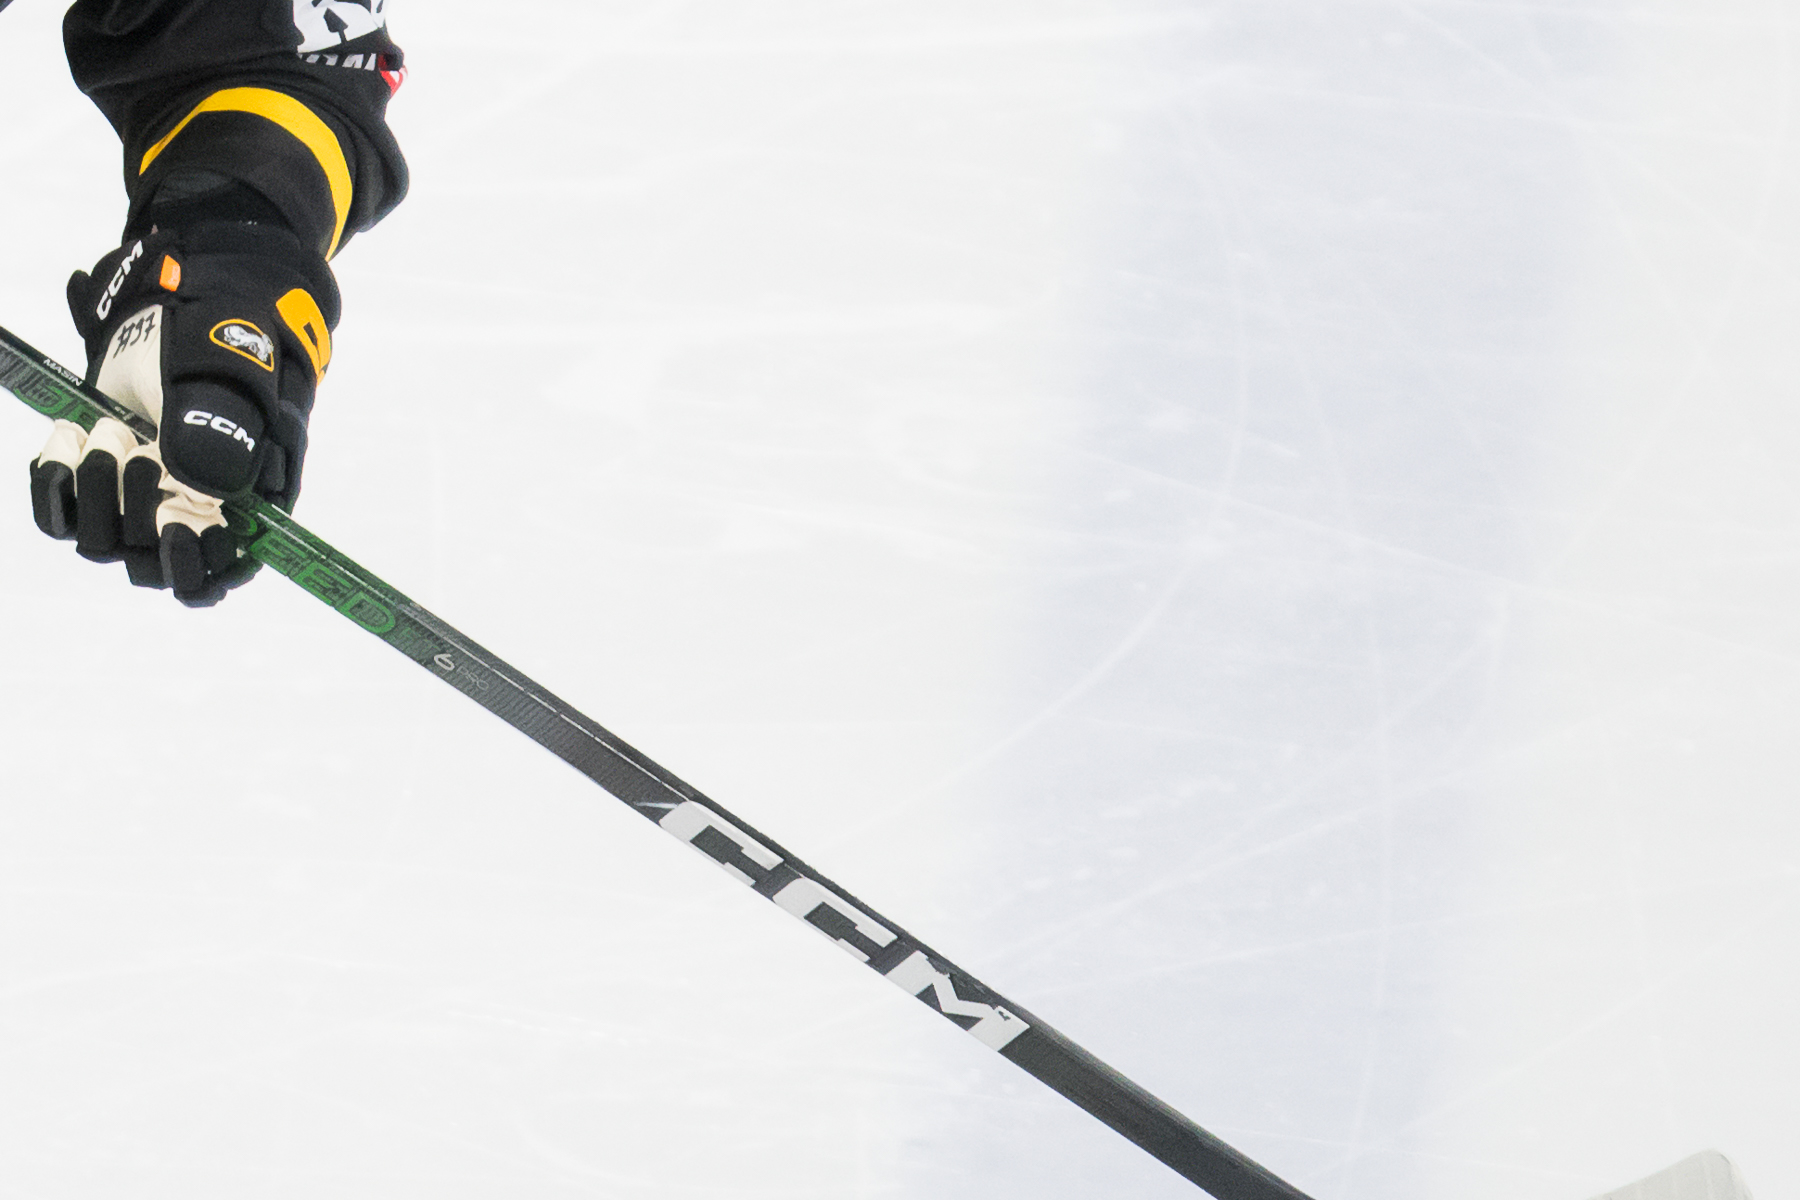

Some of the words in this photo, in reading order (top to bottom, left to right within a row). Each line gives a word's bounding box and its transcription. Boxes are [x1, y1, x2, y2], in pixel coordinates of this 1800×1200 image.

[96, 240, 144, 320] CCM
[182, 409, 257, 452] CCM
[658, 800, 1031, 1052] CCM
